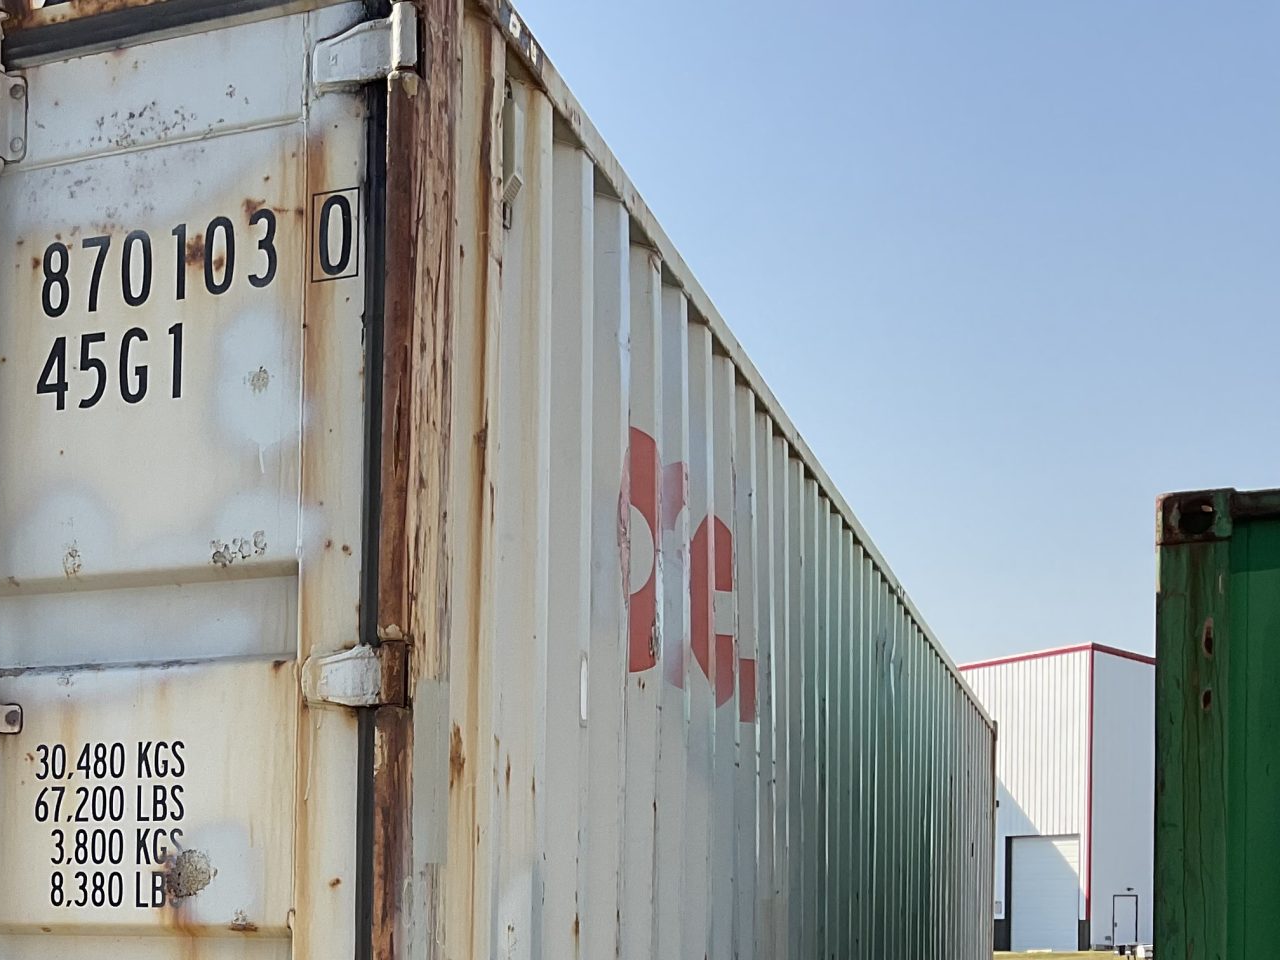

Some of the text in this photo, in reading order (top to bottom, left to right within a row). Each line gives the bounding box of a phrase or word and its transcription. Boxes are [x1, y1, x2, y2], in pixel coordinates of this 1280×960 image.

[41, 208, 278, 318] 870103
[320, 195, 353, 276] 0
[36, 322, 183, 411] 45G1
[35, 742, 125, 780] 30,480
[137, 740, 185, 779] KGS
[34, 784, 185, 823] 67,200 LBS
[50, 828, 124, 865] 3,800
[50, 871, 184, 908] 8,380 LB
